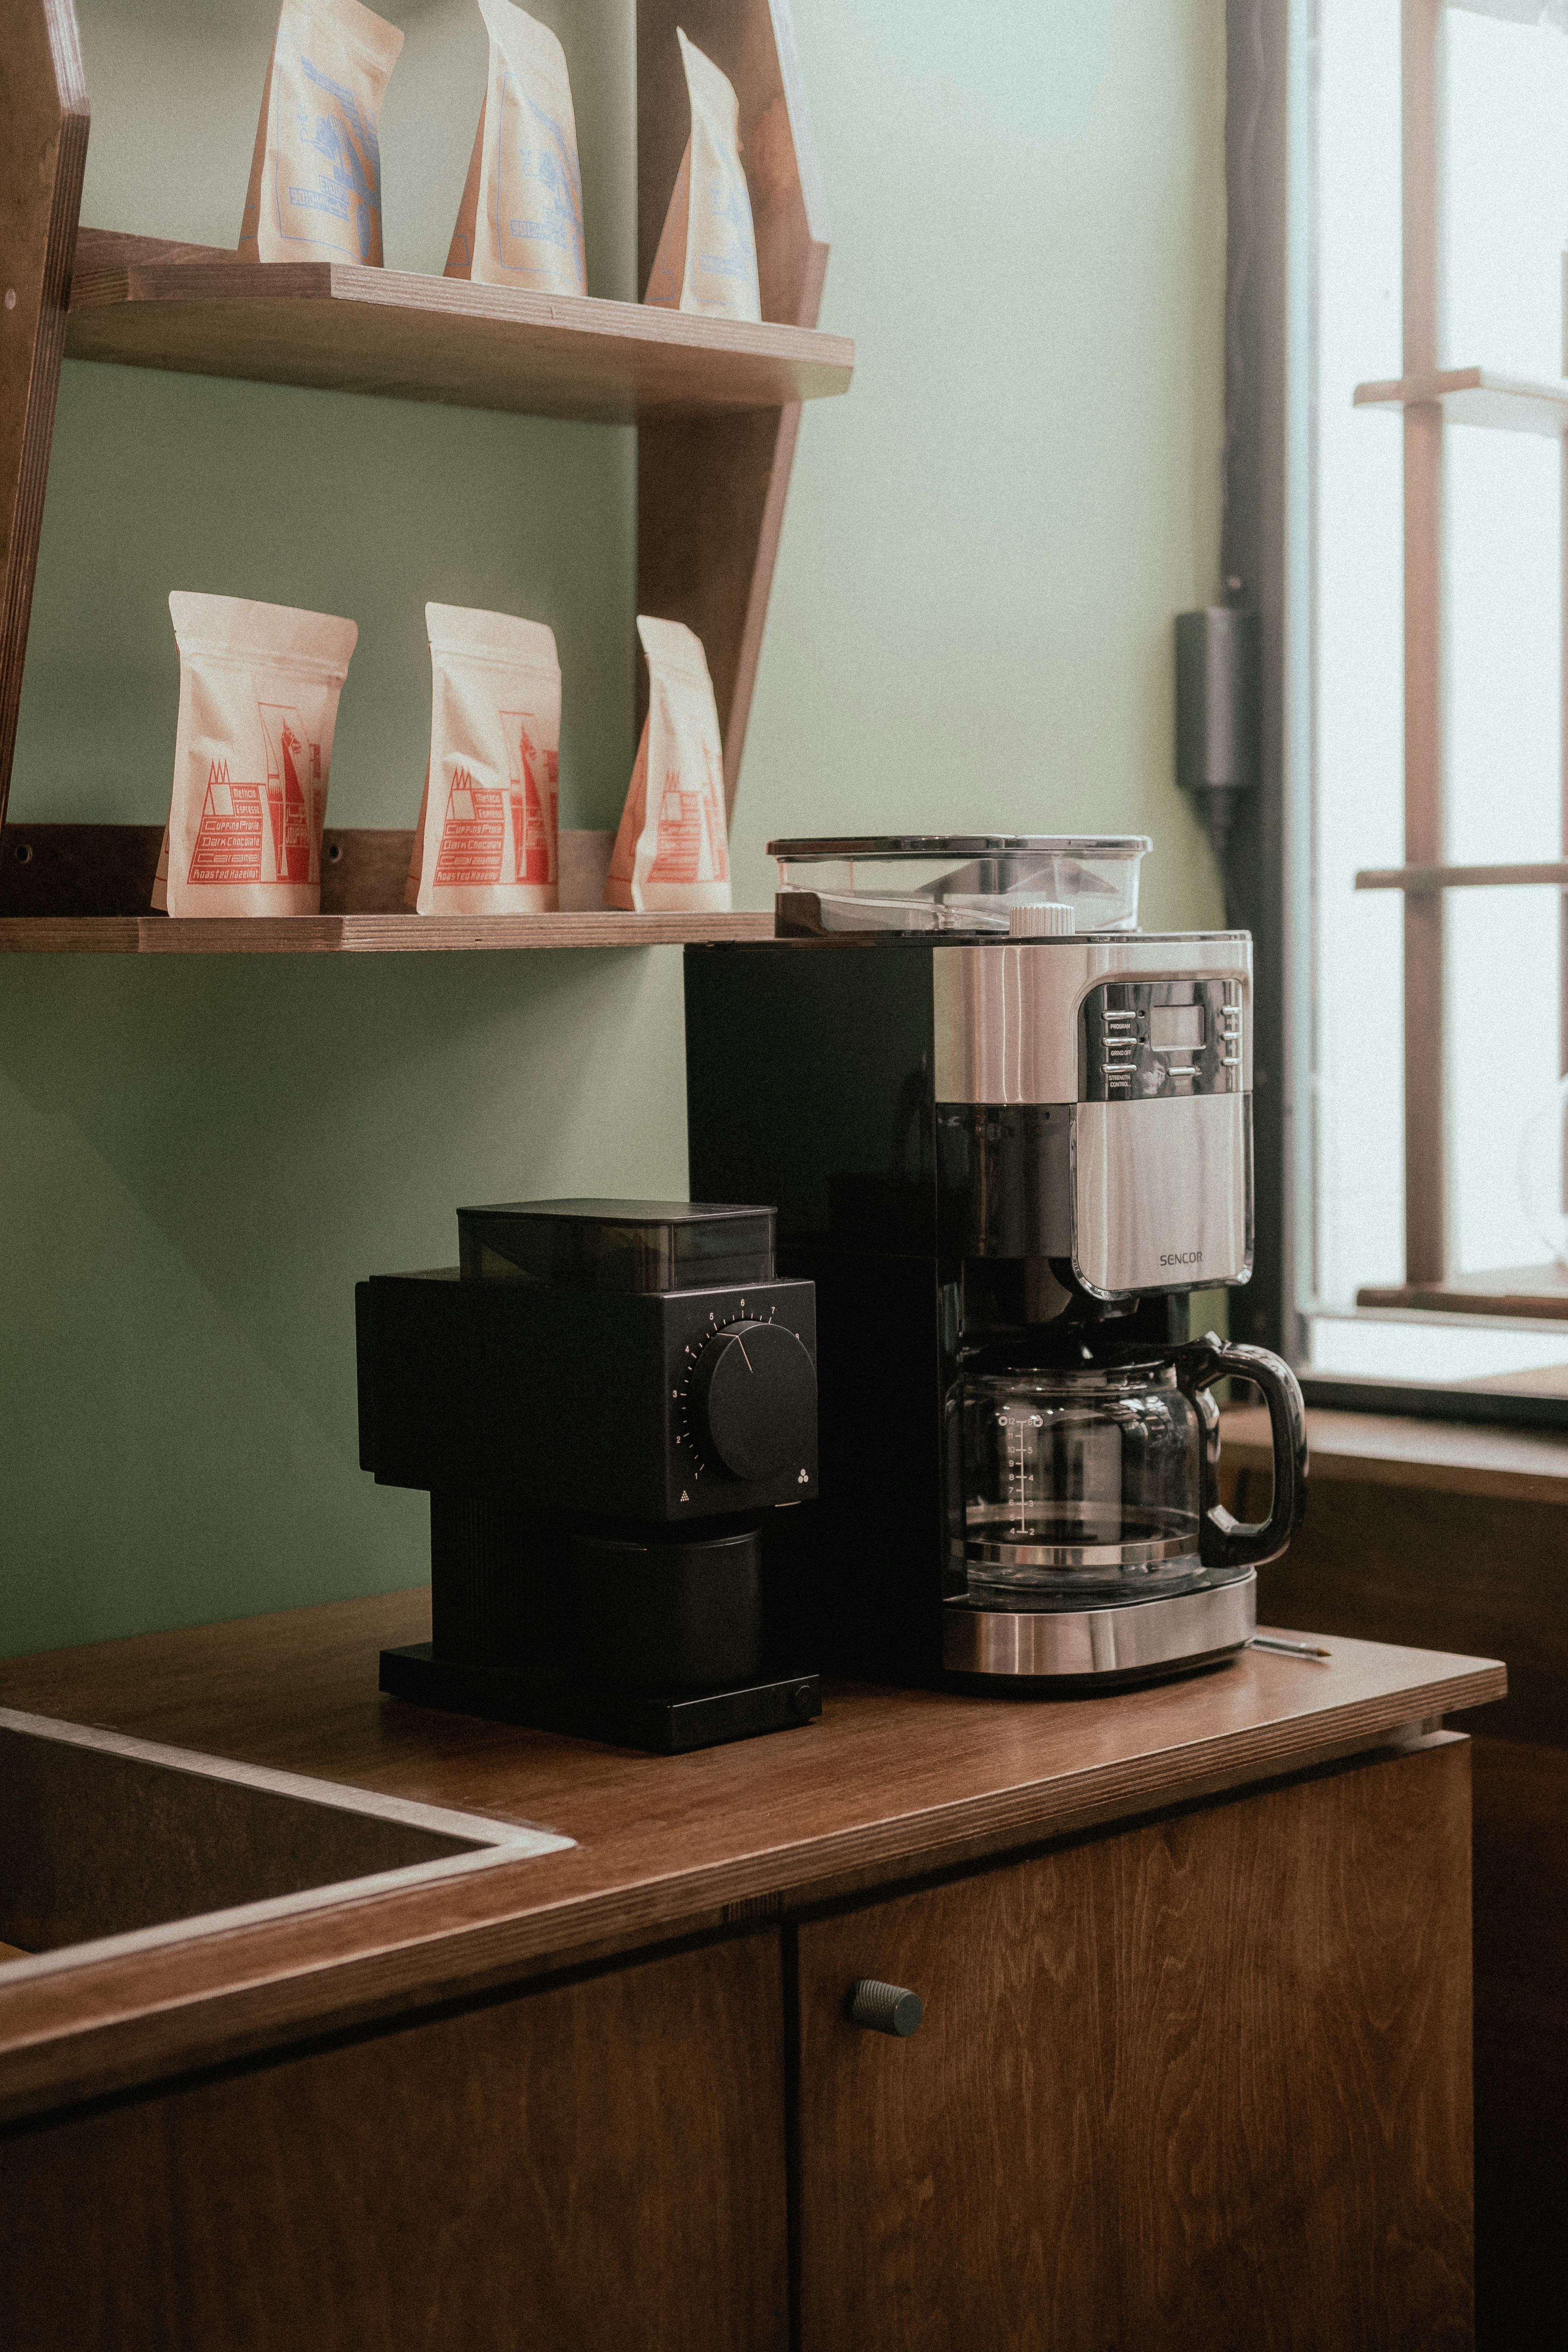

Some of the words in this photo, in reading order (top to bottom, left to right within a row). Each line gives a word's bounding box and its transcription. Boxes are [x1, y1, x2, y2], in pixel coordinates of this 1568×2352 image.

[205, 821, 239, 830] Cupping
[201, 837, 226, 846] Dark
[227, 837, 260, 846] Chocolate
[443, 840, 467, 850] Dark
[198, 853, 259, 862] Caramel
[193, 869, 229, 878] Roasted
[230, 869, 258, 878] Hazelnut
[1160, 1251, 1203, 1266] SENCOR
